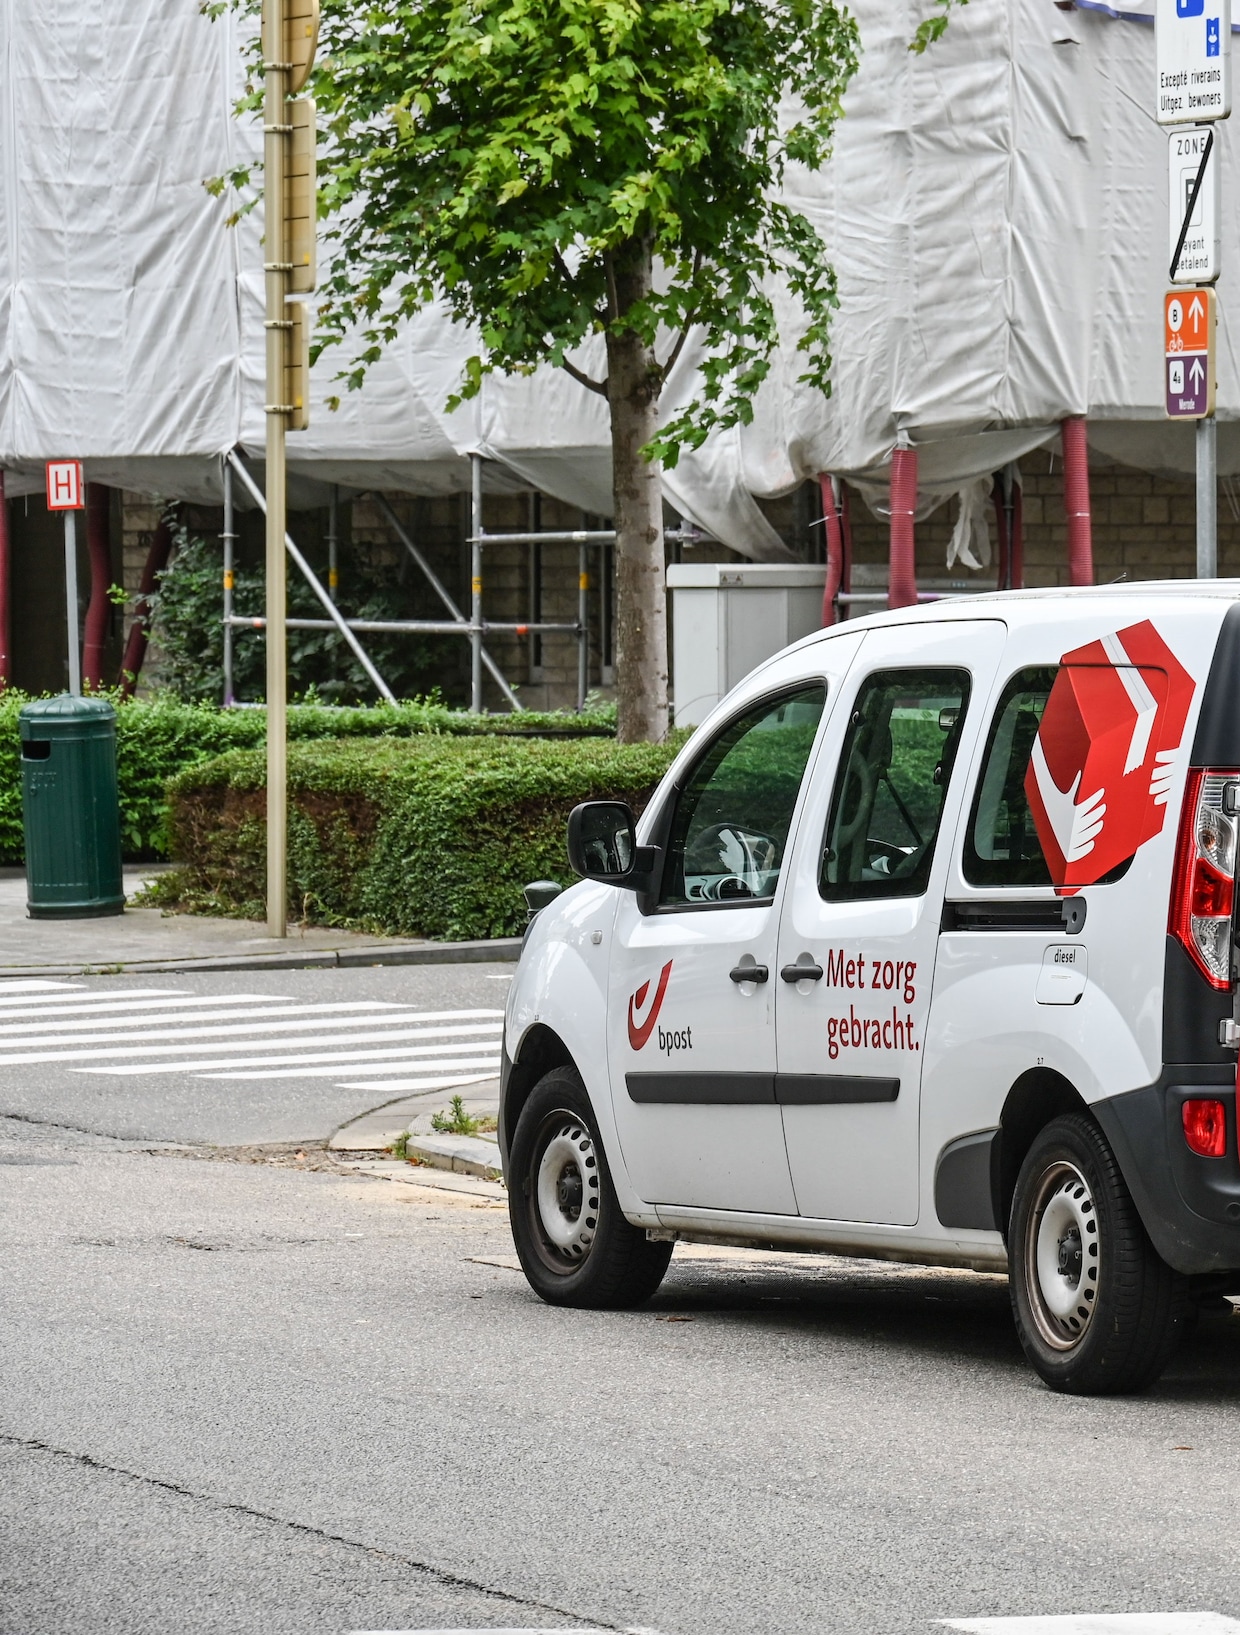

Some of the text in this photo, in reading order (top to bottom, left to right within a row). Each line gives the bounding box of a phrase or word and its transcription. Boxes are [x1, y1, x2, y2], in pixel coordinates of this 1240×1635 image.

[1160, 66, 1221, 90] Excepté riverains
[1188, 92, 1221, 108] bewoners
[1177, 137, 1205, 156] ZONE
[1182, 236, 1205, 254] ayant
[1172, 309, 1178, 323] B
[55, 470, 71, 500] H
[1054, 948, 1076, 963] diesel
[826, 949, 917, 1004] Met zorg
[658, 1025, 693, 1057] bpost
[827, 1004, 920, 1060] gebracht.
